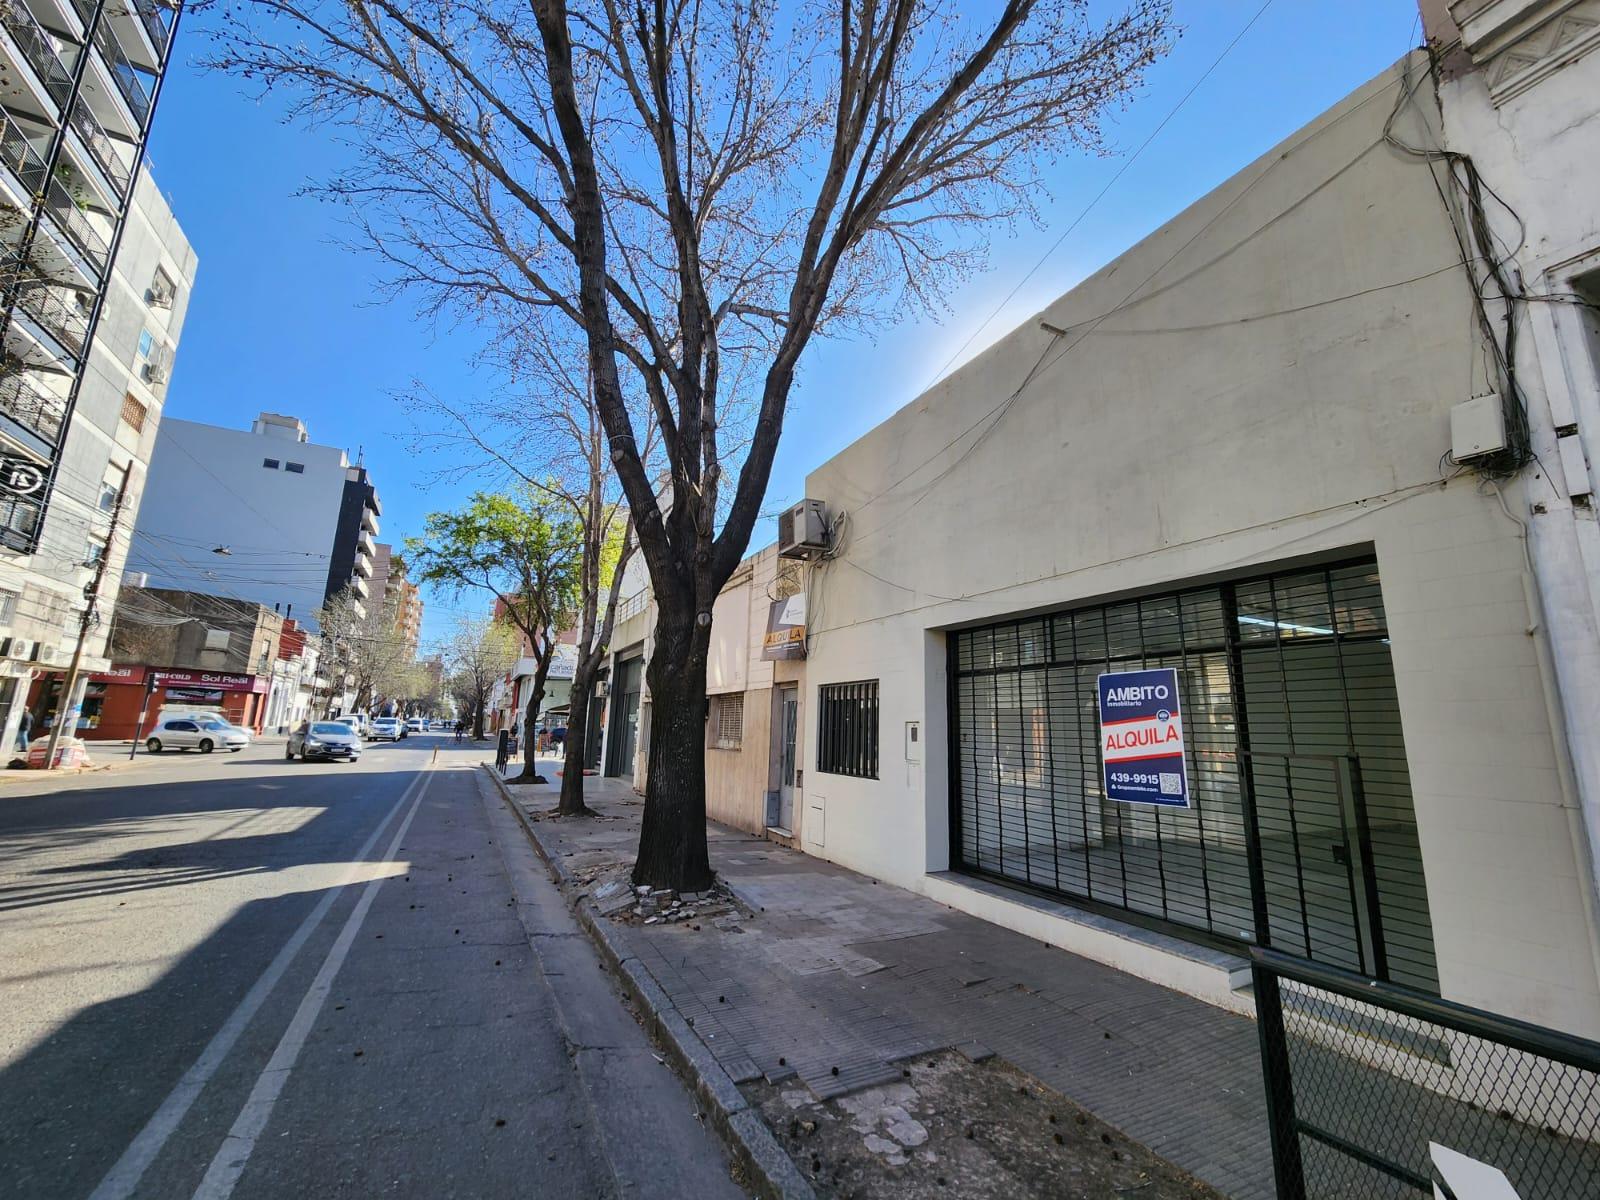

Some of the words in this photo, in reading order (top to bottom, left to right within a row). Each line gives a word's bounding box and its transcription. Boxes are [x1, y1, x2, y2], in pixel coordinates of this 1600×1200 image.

[201, 674, 220, 682] Sol
[1107, 685, 1169, 701] AMBITO
[1106, 725, 1179, 751] ALQUILA
[1110, 772, 1159, 785] 439-9915
